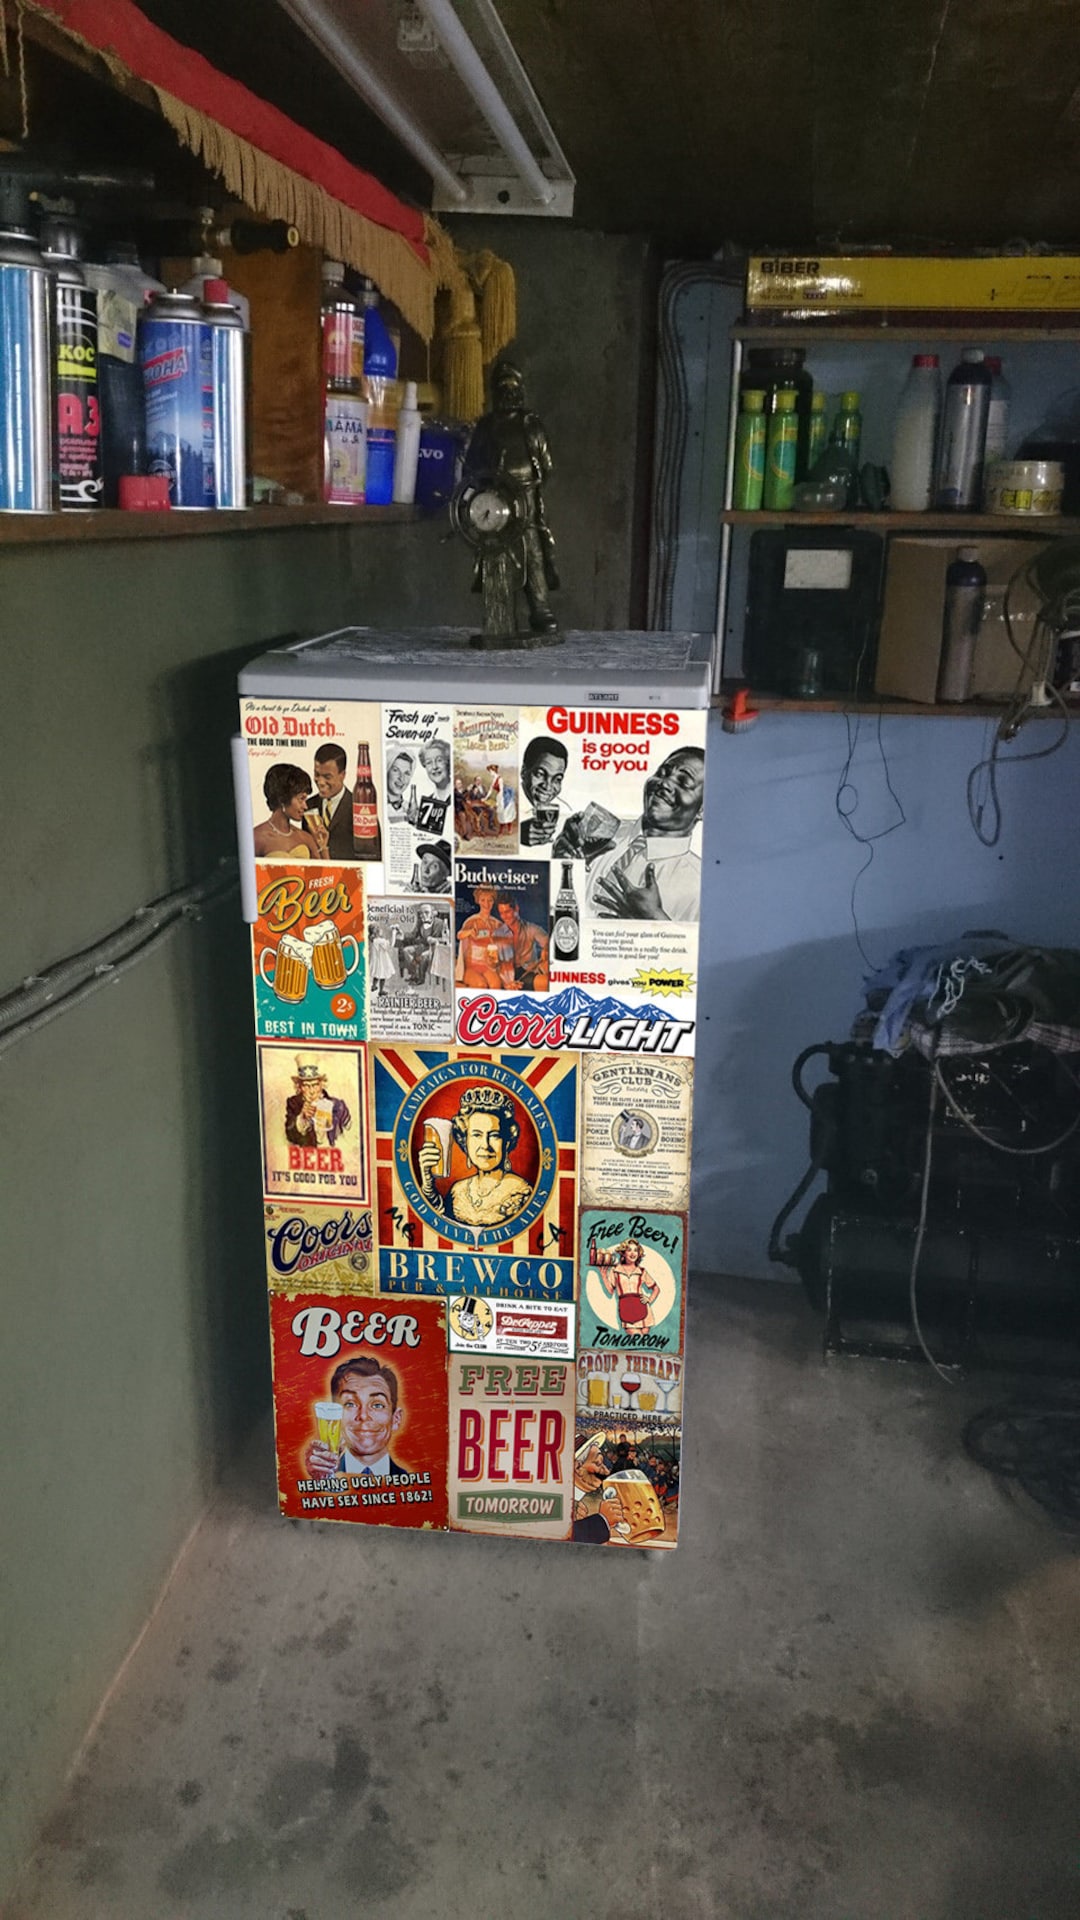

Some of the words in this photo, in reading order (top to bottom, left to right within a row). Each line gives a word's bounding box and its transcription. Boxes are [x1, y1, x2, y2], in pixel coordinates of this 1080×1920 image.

[245, 715, 279, 736] Old
[546, 706, 680, 736] GUINNESS
[247, 738, 257, 746] THE
[259, 738, 274, 746] GOOD
[275, 738, 289, 747] TIME
[582, 739, 597, 753] is
[600, 740, 650, 757] good
[581, 755, 610, 771] for
[613, 759, 648, 775] you
[309, 875, 335, 890] FRESH
[455, 863, 539, 884] Budweiser
[257, 875, 353, 933] Beer
[592, 929, 604, 937] You
[644, 946, 658, 954] really
[631, 980, 647, 988] you
[649, 978, 684, 987] POWER
[265, 1020, 295, 1034] BEST
[301, 1021, 314, 1036] IN
[321, 1022, 358, 1037] TOWN
[457, 995, 568, 1048] Coors
[568, 1017, 695, 1054] LIGHT
[592, 1066, 681, 1087] GENTLEMANS
[621, 1076, 652, 1086] CLUB
[402, 1067, 457, 1122] CAMPAIGN
[460, 1063, 488, 1077] FOR
[491, 1068, 524, 1097] REAL
[527, 1097, 549, 1129] ALES
[288, 1146, 344, 1172] BEER
[272, 1171, 291, 1182] IT'S
[293, 1172, 316, 1184] GOOD
[319, 1174, 336, 1185] FOR
[339, 1175, 358, 1186] YOU
[404, 1181, 428, 1214] GOD
[432, 1217, 472, 1243] SAVE
[482, 1227, 514, 1243] THE
[520, 1190, 548, 1225] ALES
[266, 1209, 373, 1274] Coors
[586, 1219, 625, 1249] Free
[628, 1215, 679, 1255] Beer!
[387, 1251, 563, 1290] BREWCO
[388, 1280, 423, 1292] PUB
[291, 1306, 421, 1358] BEER
[592, 1326, 670, 1349] TOMORROW
[578, 1354, 618, 1379] GROUP
[625, 1354, 682, 1381] THERAPY
[458, 1364, 567, 1396] FREE
[594, 1410, 638, 1421] PRACTICED
[642, 1415, 662, 1423] HERE
[457, 1408, 566, 1484] BEER
[297, 1478, 349, 1492] HELPING
[351, 1475, 382, 1490] UGLY
[384, 1472, 431, 1487] PEOPLE
[302, 1495, 335, 1509] HAVE
[337, 1494, 360, 1508] SEX
[361, 1492, 396, 1507] SINCE
[399, 1489, 433, 1504] 1862!
[465, 1496, 555, 1515] TOMORROW
